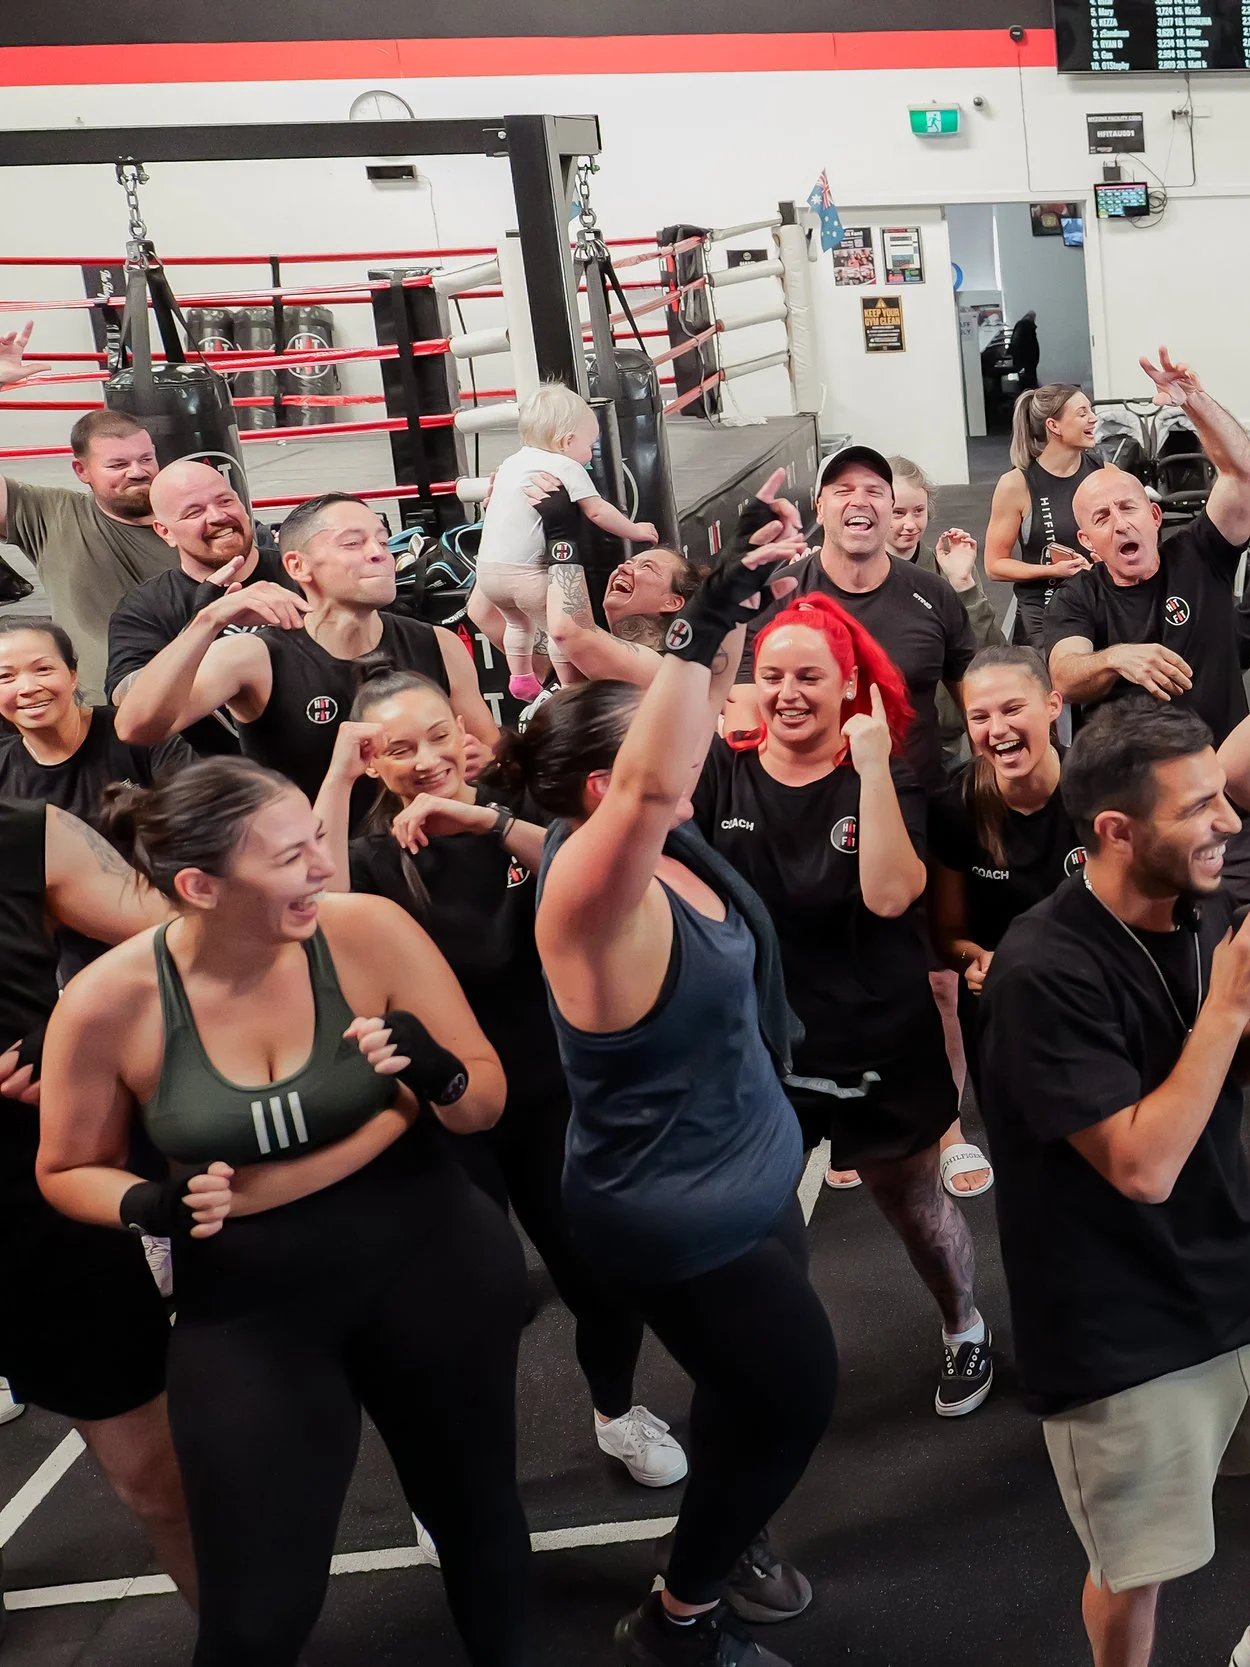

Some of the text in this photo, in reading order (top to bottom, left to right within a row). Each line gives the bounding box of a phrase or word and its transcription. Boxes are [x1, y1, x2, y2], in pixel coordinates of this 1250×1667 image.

[864, 308, 900, 318] KEEP YOUR
[1040, 497, 1056, 542] HITFIT
[314, 699, 330, 709] HIT
[315, 711, 330, 721] FIT
[972, 866, 1009, 880] COACH
